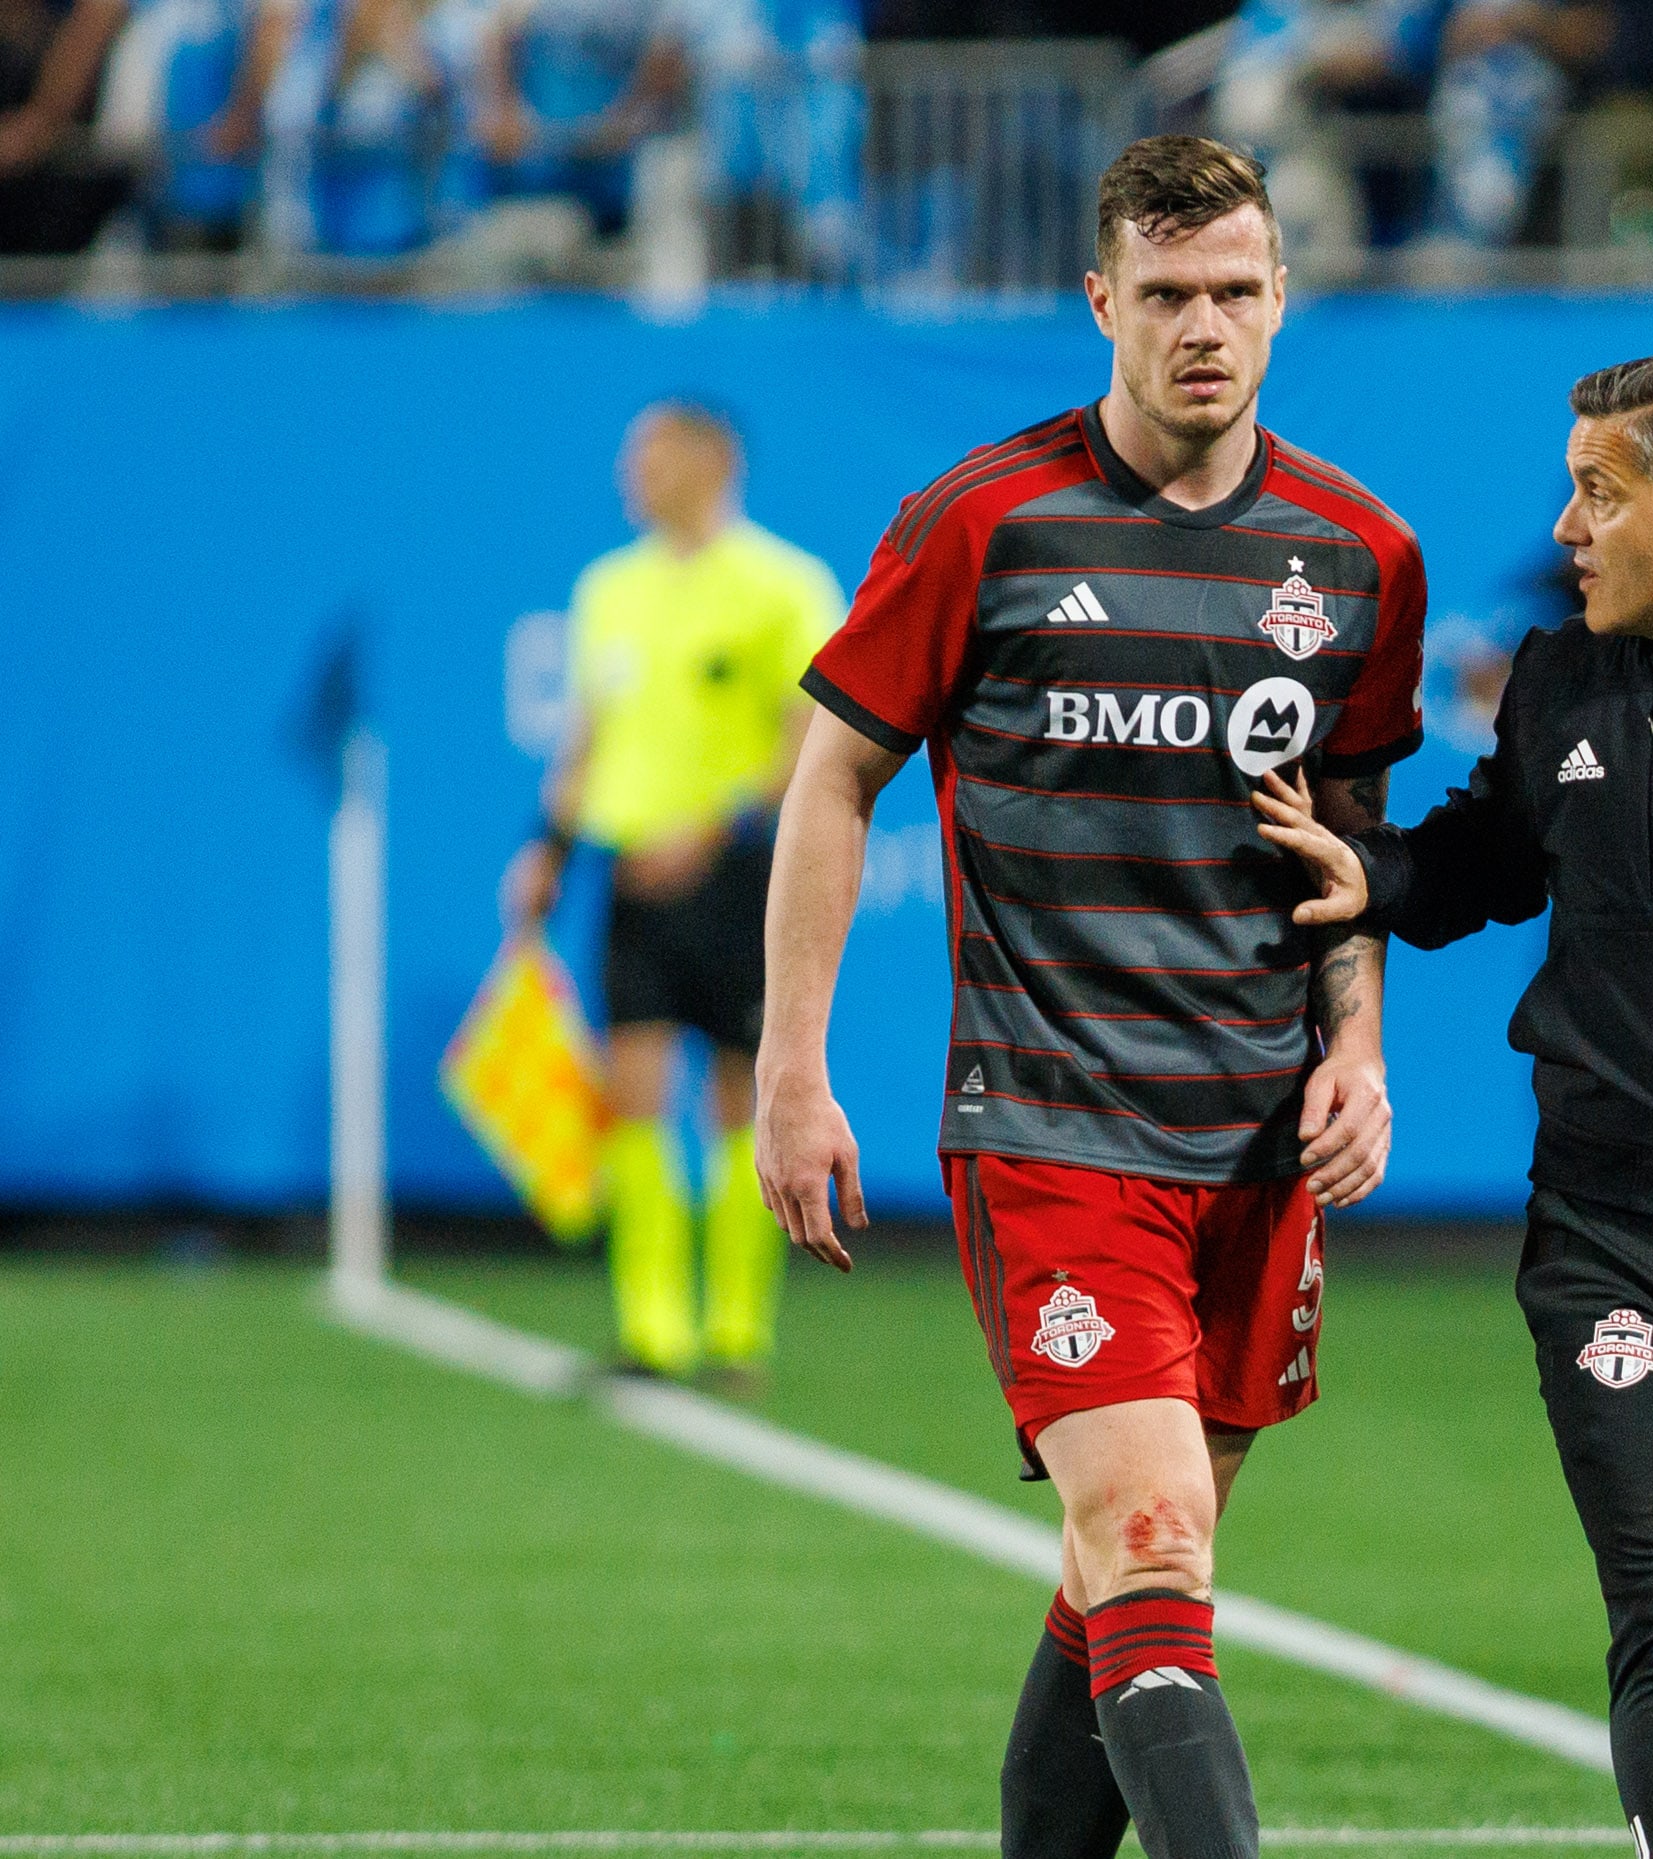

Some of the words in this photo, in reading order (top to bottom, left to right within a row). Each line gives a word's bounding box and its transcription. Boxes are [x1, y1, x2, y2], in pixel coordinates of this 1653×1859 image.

[1270, 613, 1324, 630] TORONTO
[1043, 690, 1211, 748] BMO
[1557, 764, 1605, 783] adidas
[1040, 1320, 1100, 1341] TORONTO
[1588, 1343, 1653, 1360] TORONTO
